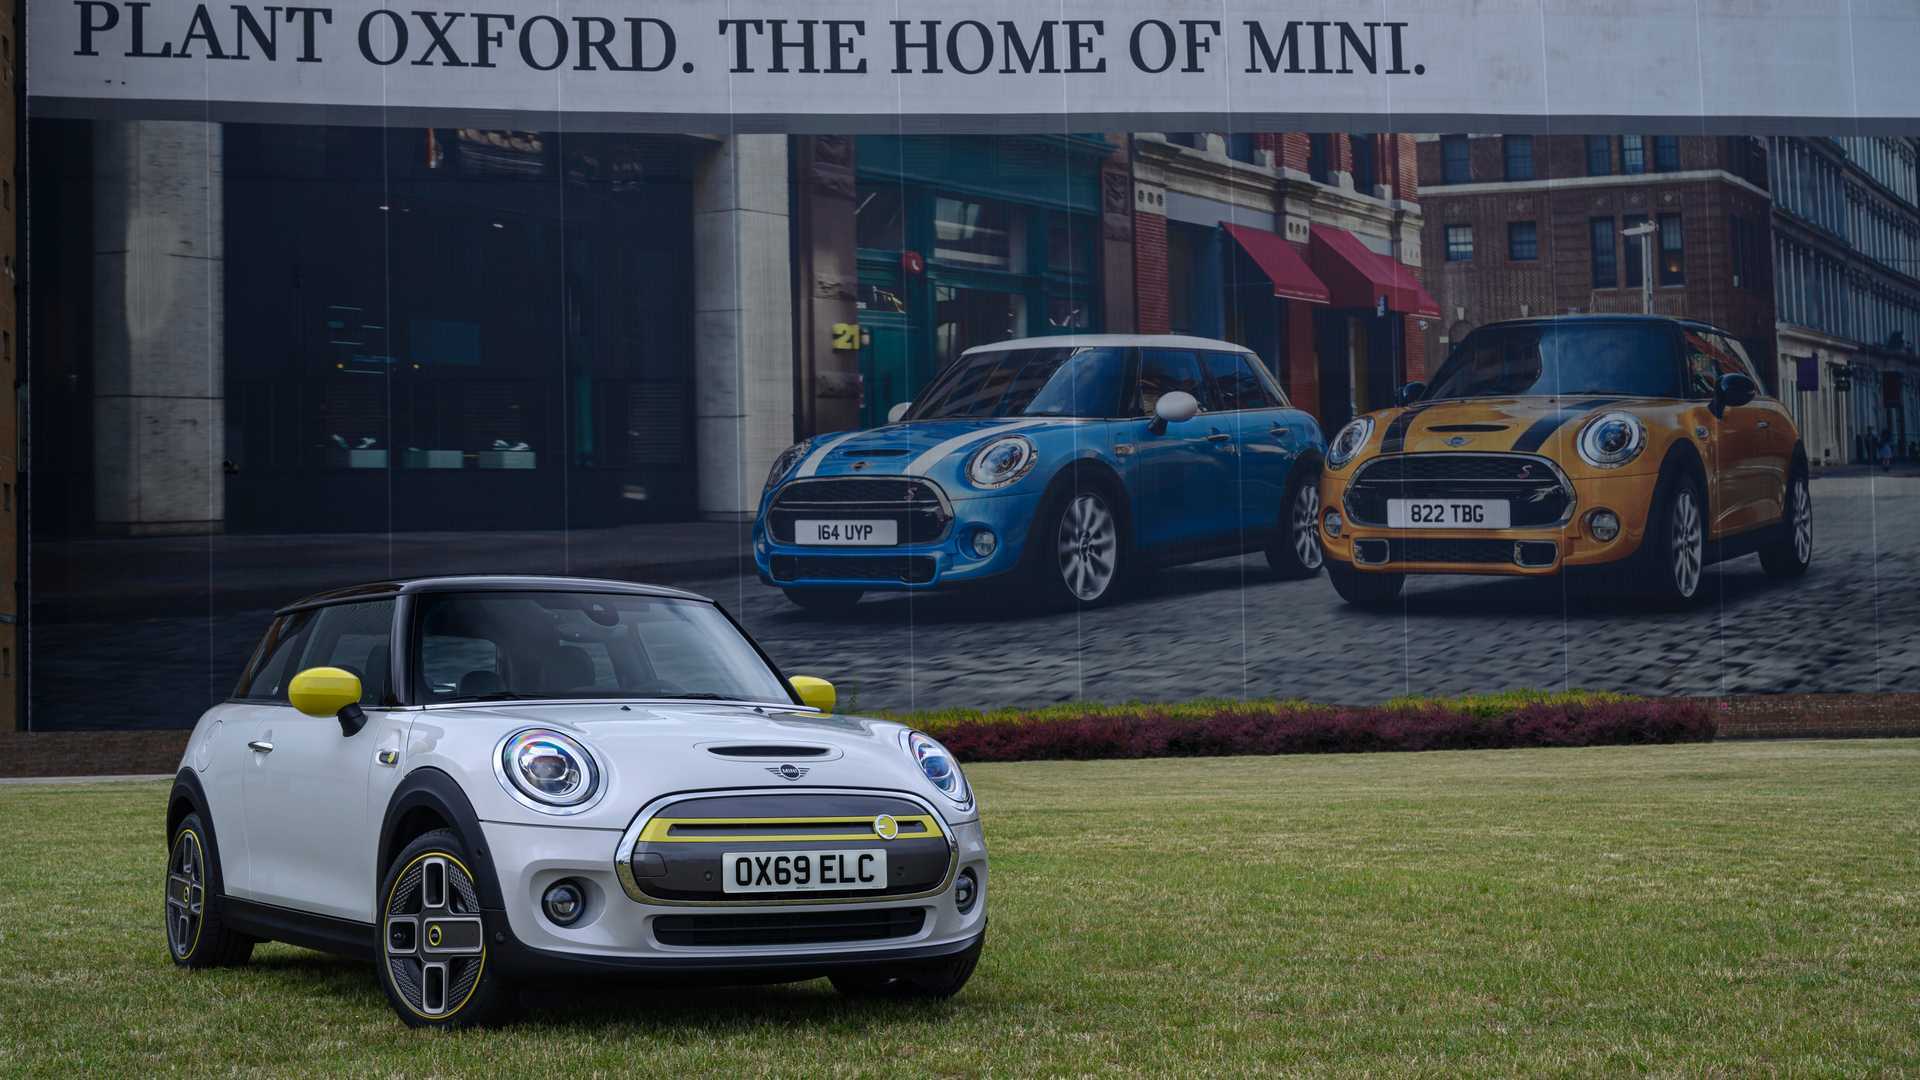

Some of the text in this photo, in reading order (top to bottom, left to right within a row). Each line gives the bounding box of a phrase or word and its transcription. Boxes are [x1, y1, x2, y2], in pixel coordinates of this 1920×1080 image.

[73, 0, 1426, 76] PLANT OXFORD. THE HOME OF MINI.
[1411, 504, 1484, 523] 822 TBG
[818, 525, 873, 541] 164 UYP
[735, 853, 875, 886] OX69 ELC
